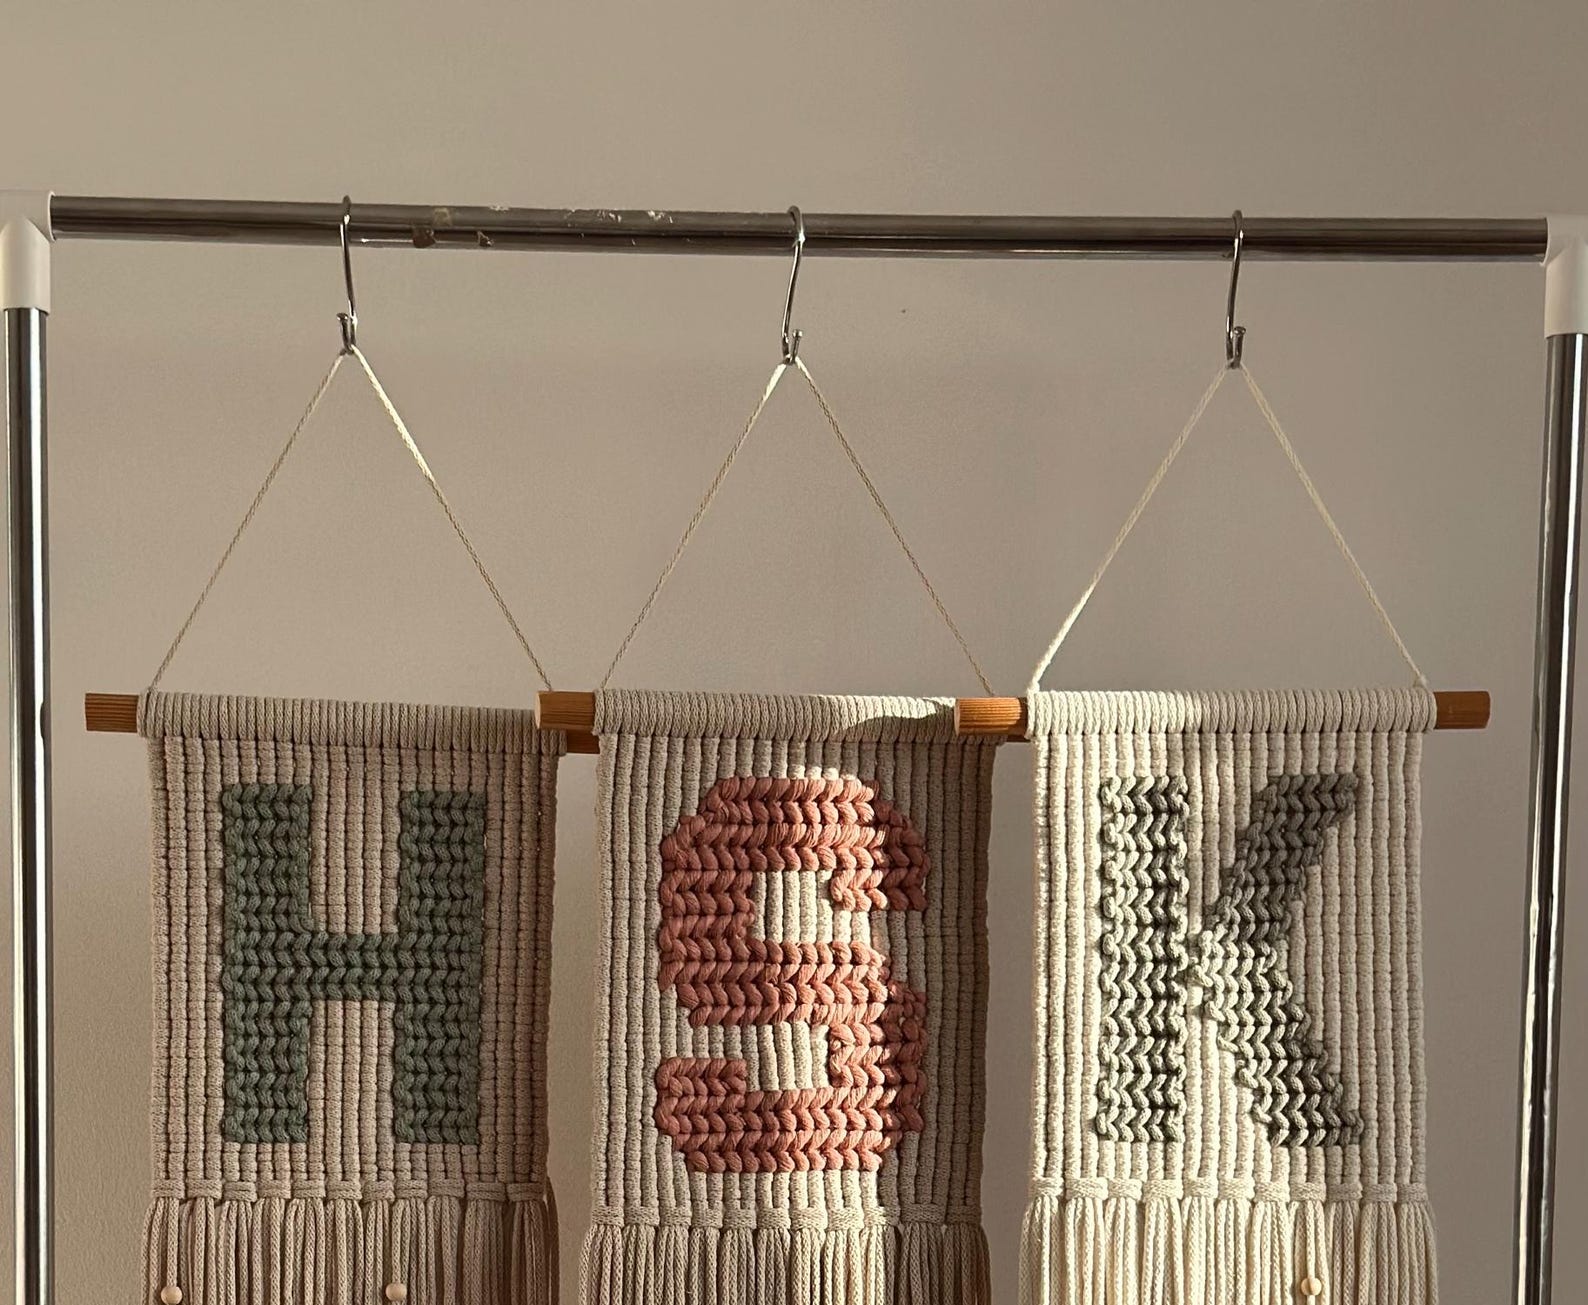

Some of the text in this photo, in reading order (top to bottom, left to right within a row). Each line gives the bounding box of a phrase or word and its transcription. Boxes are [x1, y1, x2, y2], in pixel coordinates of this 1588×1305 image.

[222, 783, 486, 1144] H
[655, 776, 931, 1173] S
[1096, 774, 1364, 1147] K
